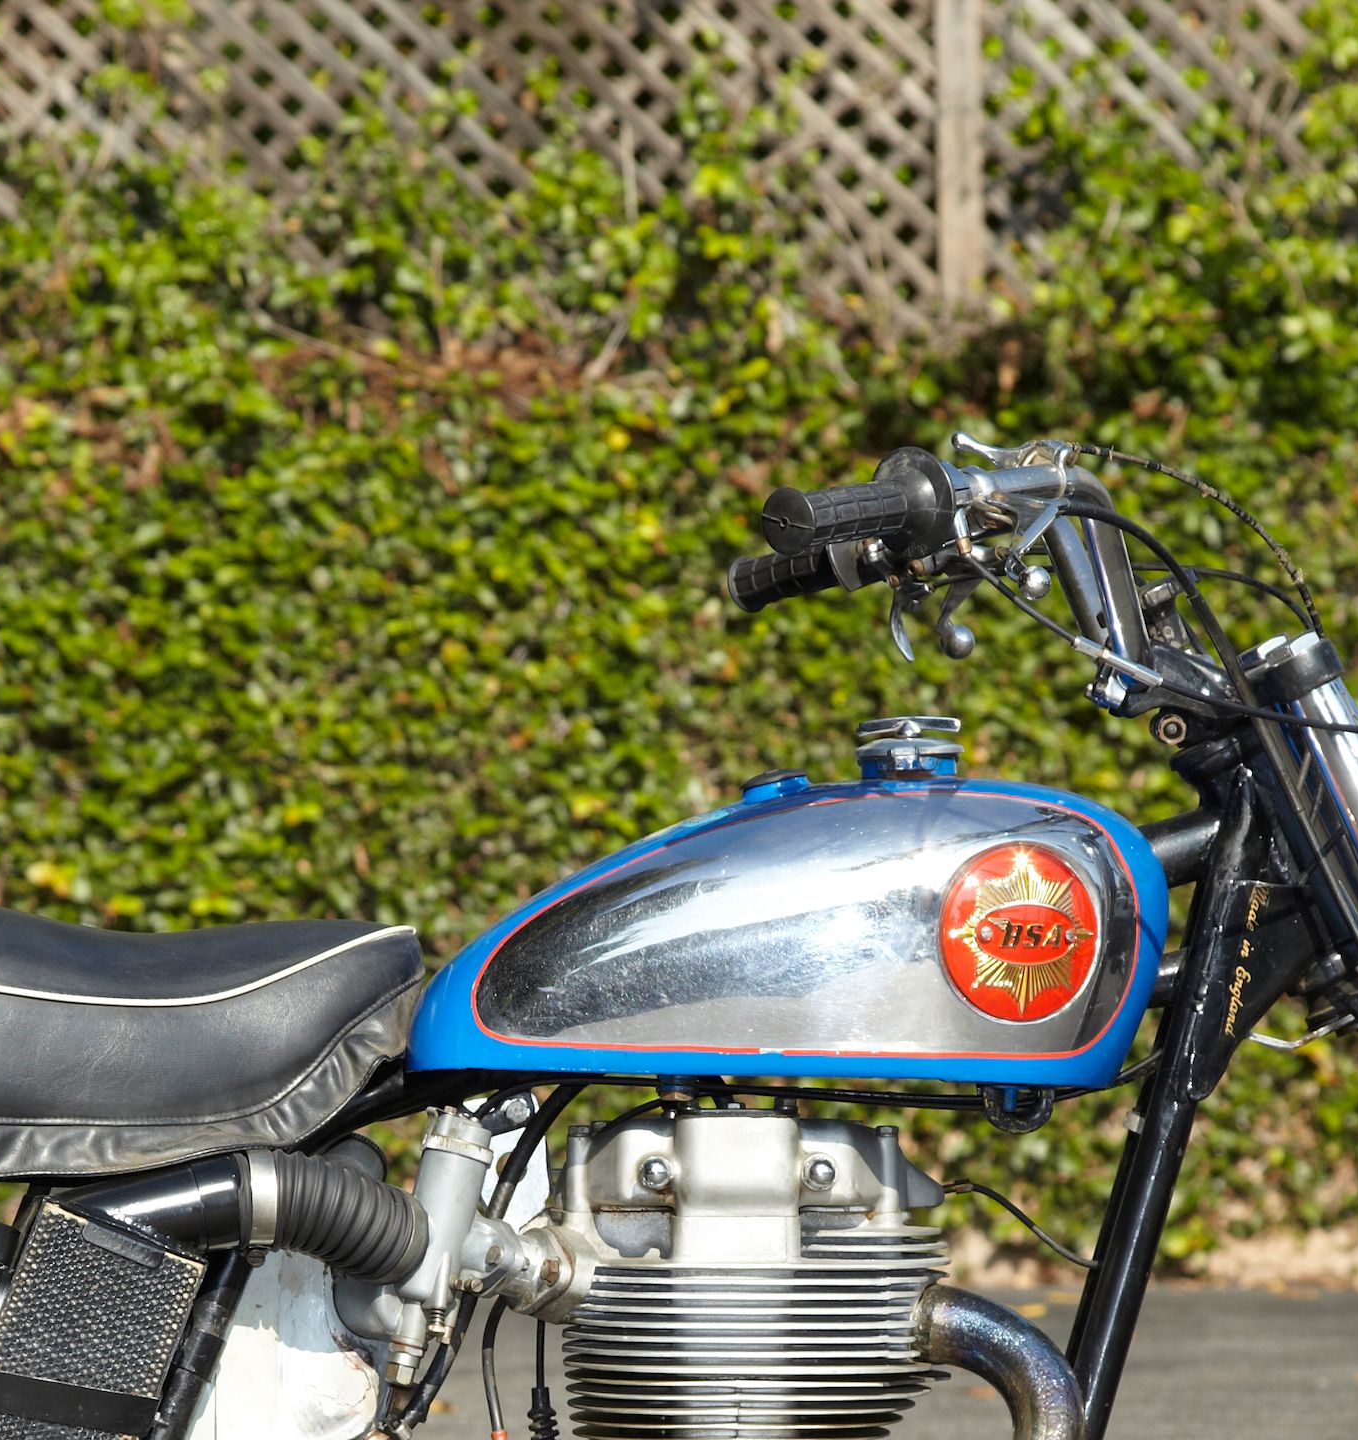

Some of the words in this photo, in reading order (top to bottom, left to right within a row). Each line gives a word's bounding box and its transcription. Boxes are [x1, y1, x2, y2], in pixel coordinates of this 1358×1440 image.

[1246, 885, 1271, 932] Made
[999, 922, 1063, 949] BSA
[1240, 937, 1255, 959] in
[1224, 965, 1252, 1039] England
